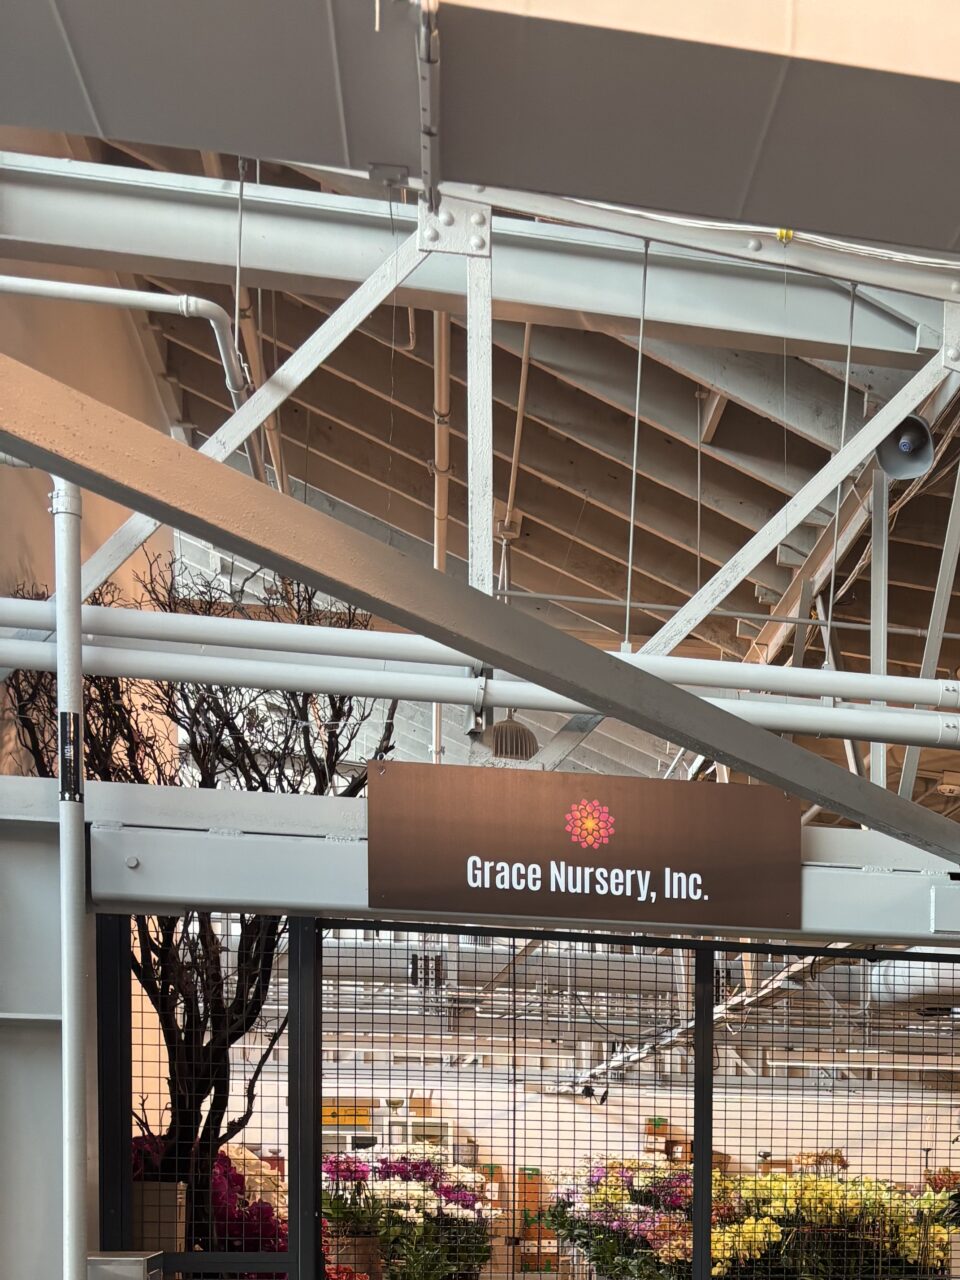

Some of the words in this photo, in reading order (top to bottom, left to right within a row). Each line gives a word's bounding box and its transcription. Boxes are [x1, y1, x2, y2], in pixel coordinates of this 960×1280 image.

[467, 855, 542, 891] Grace
[550, 860, 657, 903] Nursery,
[664, 867, 709, 901] Inc.
